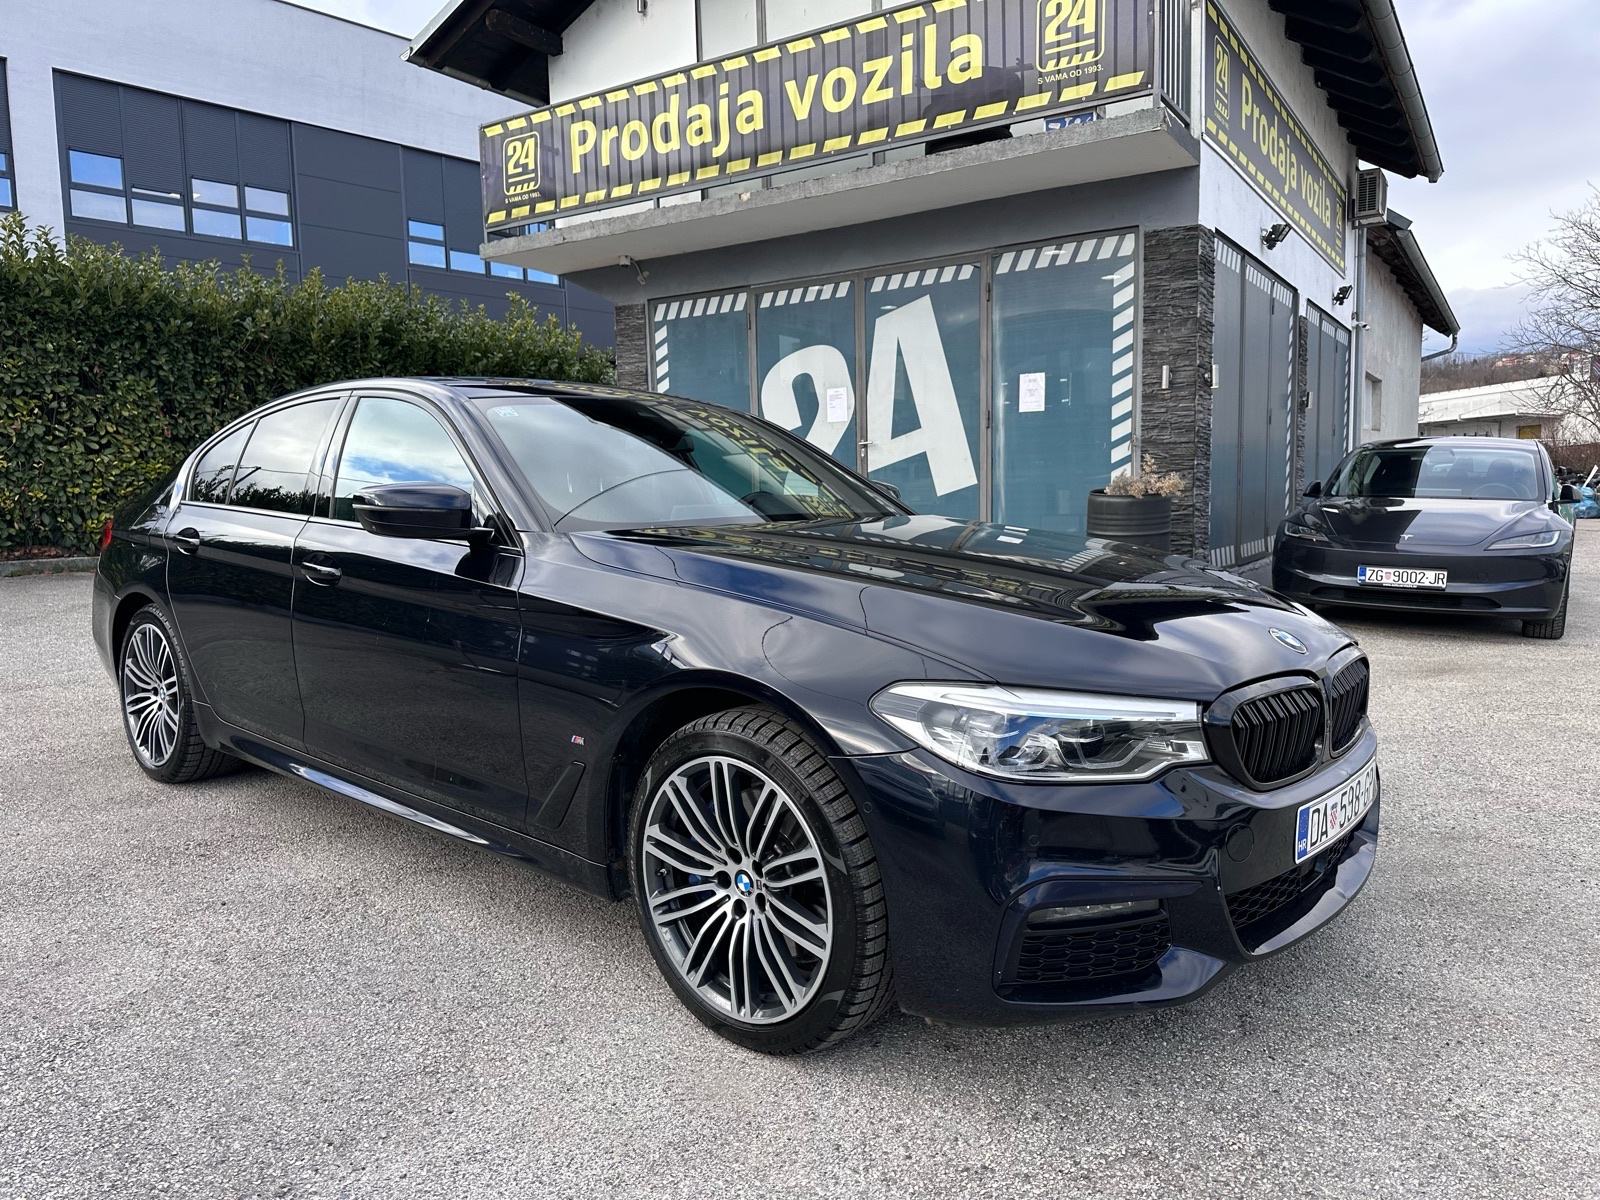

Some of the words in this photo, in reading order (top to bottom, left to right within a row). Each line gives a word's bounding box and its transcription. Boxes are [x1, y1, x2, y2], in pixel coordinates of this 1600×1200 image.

[1044, 0, 1096, 44] 24
[1037, 77, 1044, 85] S
[1044, 72, 1068, 83] VAMA
[1069, 69, 1082, 78] OD
[1084, 64, 1104, 75] 1993.
[1216, 43, 1228, 94] 24
[570, 82, 764, 174] Prodaja
[784, 23, 983, 121] vozila
[507, 137, 535, 175] 24
[1241, 73, 1297, 195] Prodaja
[1300, 164, 1331, 229] vozila
[1367, 568, 1384, 582] ZG
[1392, 570, 1446, 585] 9002-JR
[1298, 838, 1307, 851] HR
[1310, 803, 1328, 848] DA
